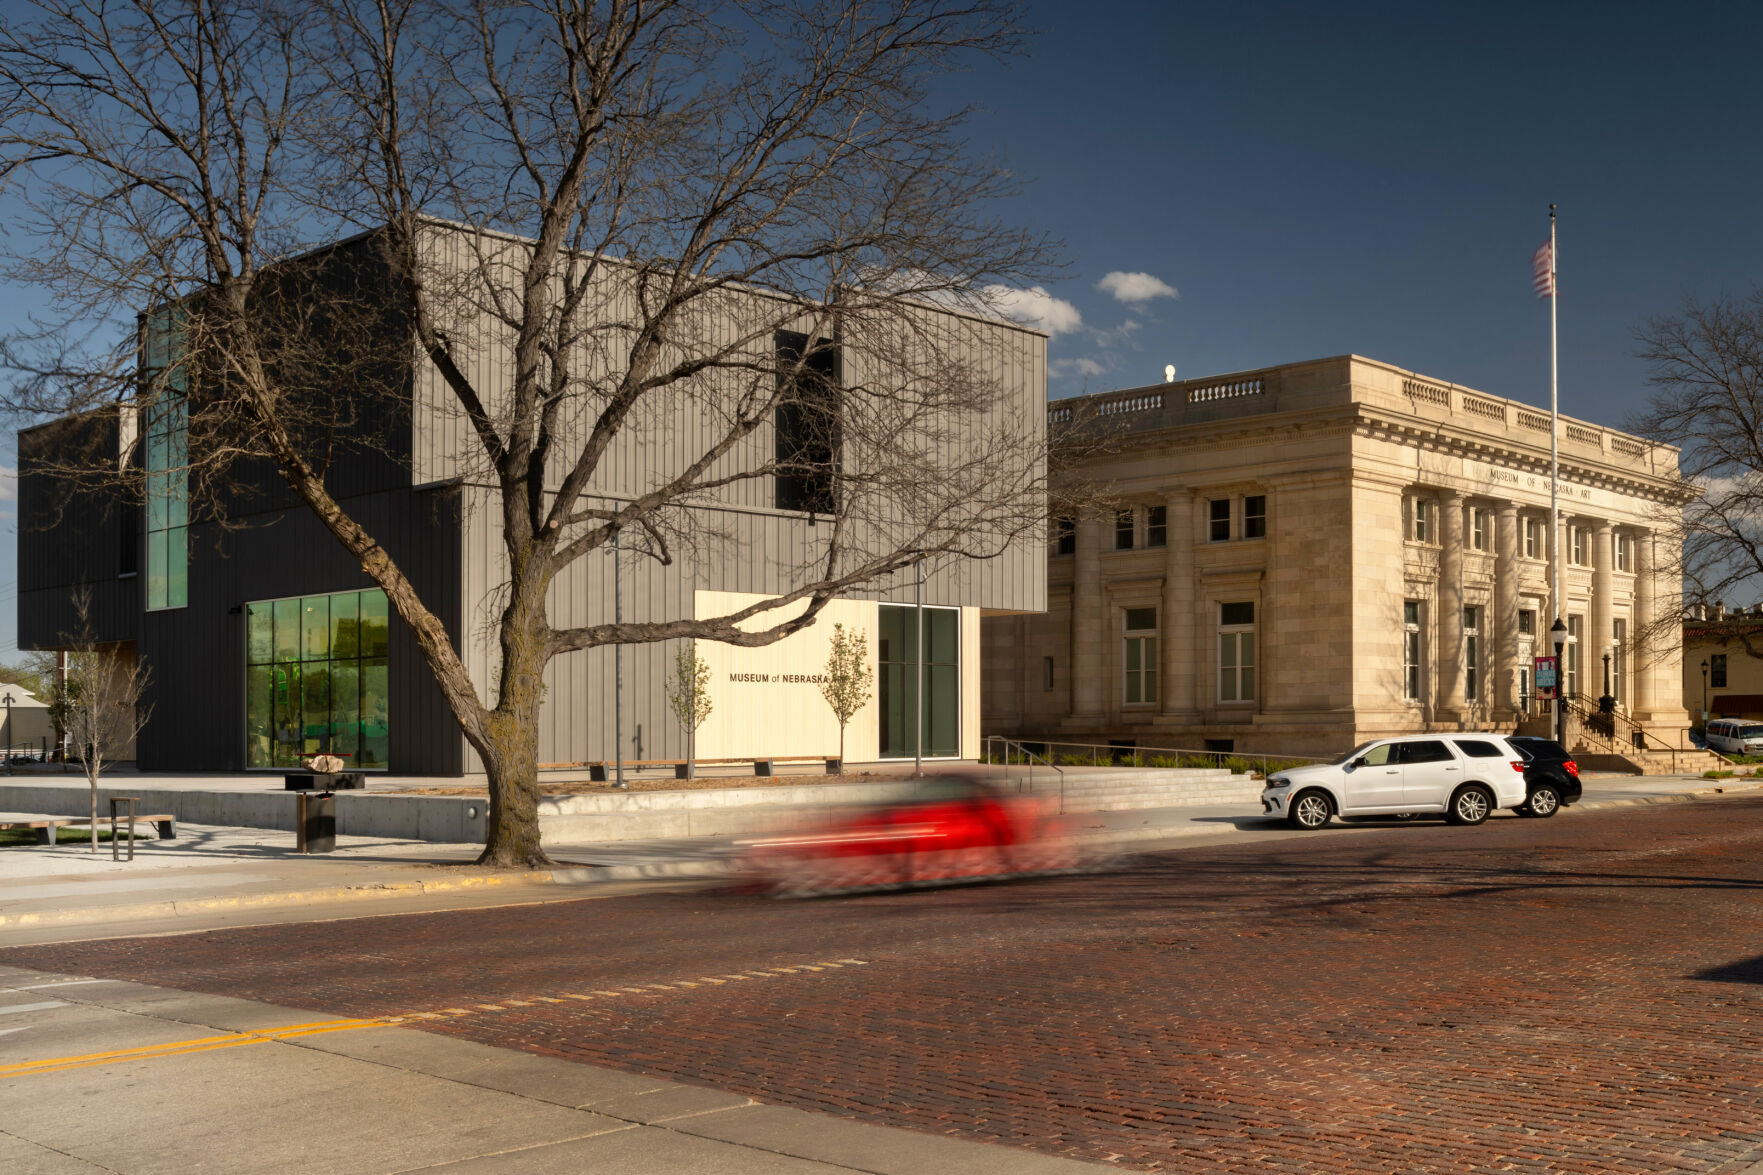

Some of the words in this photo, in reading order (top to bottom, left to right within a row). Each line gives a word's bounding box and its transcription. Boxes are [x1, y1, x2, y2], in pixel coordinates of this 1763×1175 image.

[1490, 469, 1519, 484] MUSEUM
[1527, 477, 1535, 488] OF
[1543, 480, 1573, 496] NEASKA
[1580, 489, 1592, 499] ART
[729, 673, 769, 683] MUSEUM
[771, 674, 780, 683] of
[782, 674, 829, 684] NEBRASKA
